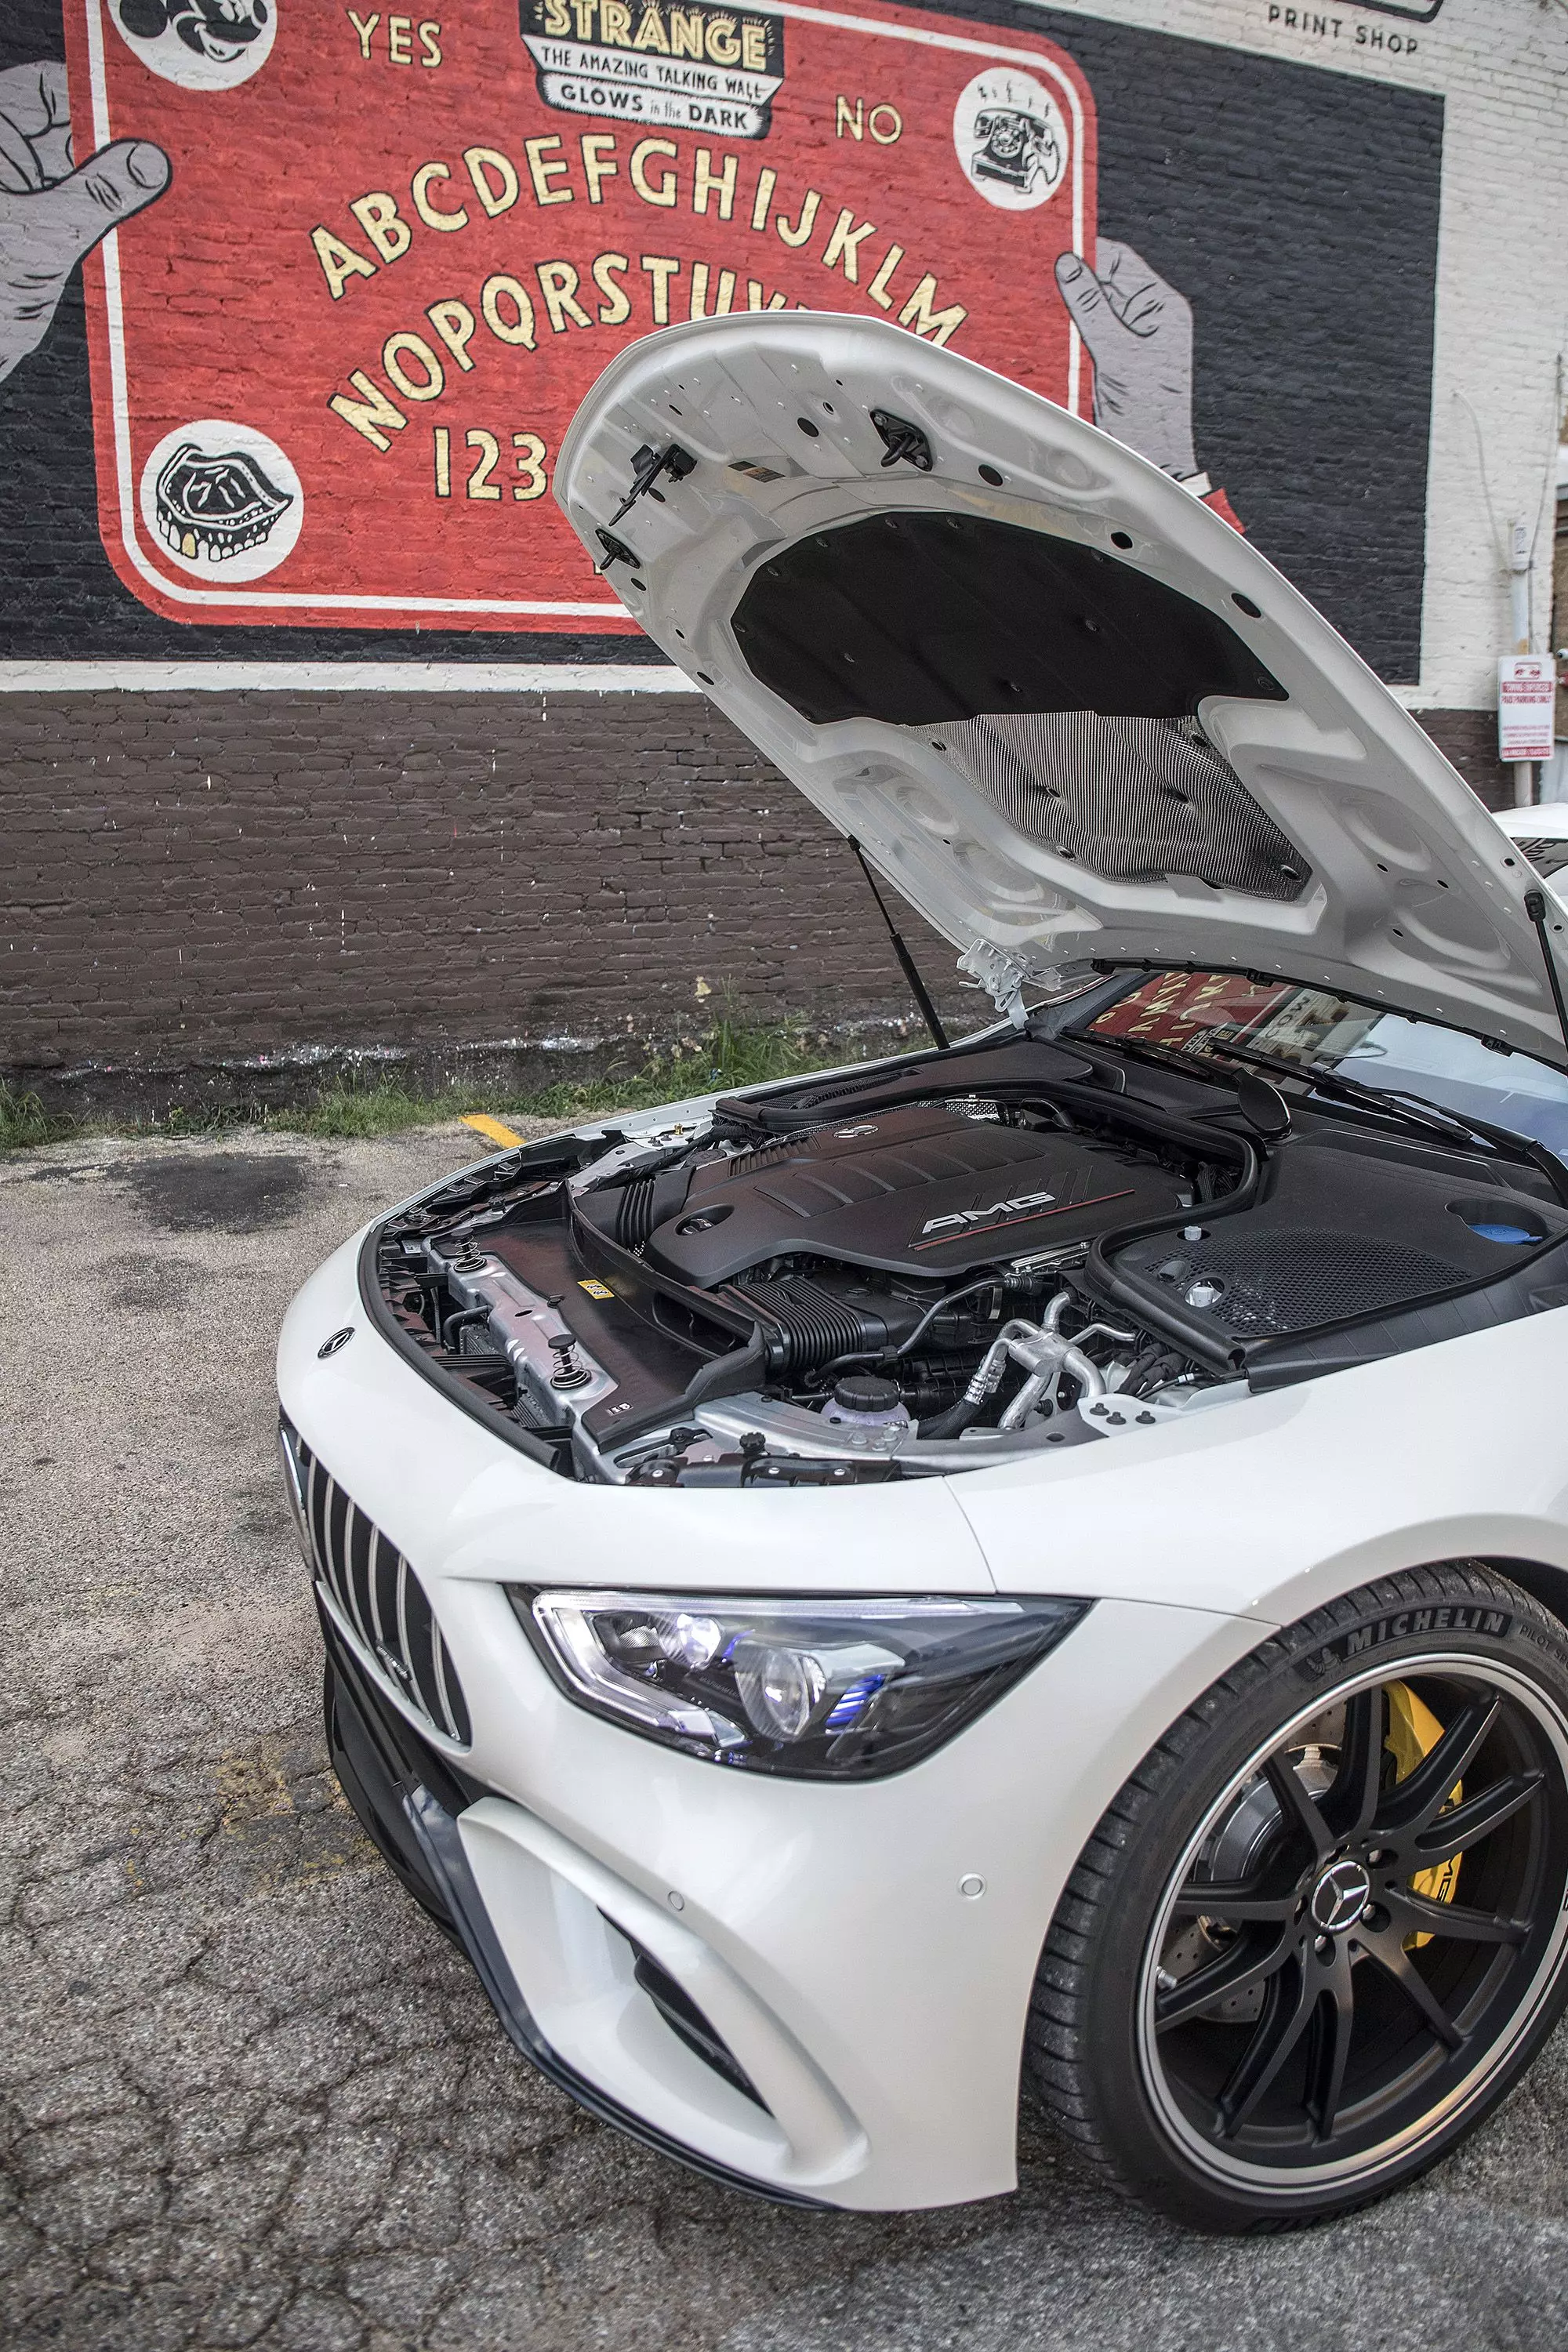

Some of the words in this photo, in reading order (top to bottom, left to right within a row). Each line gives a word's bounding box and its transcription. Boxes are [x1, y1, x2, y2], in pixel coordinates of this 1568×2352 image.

[348, 10, 442, 68] YES
[544, 0, 768, 72] STRANGE
[1269, 4, 1342, 38] PRINT
[1355, 25, 1418, 55] SHOP
[541, 45, 572, 67] THE
[579, 54, 648, 79] AMAZING
[656, 64, 718, 92] TALKING
[725, 77, 763, 100] WALL
[561, 83, 644, 112] GLOWS
[650, 100, 661, 115] in
[663, 102, 682, 118] the
[688, 104, 748, 129] DARK
[835, 94, 902, 145] NO
[921, 1191, 1056, 1234] AMG
[1346, 1608, 1504, 1657] MICHELIN
[1519, 1623, 1552, 1652] PILOT
